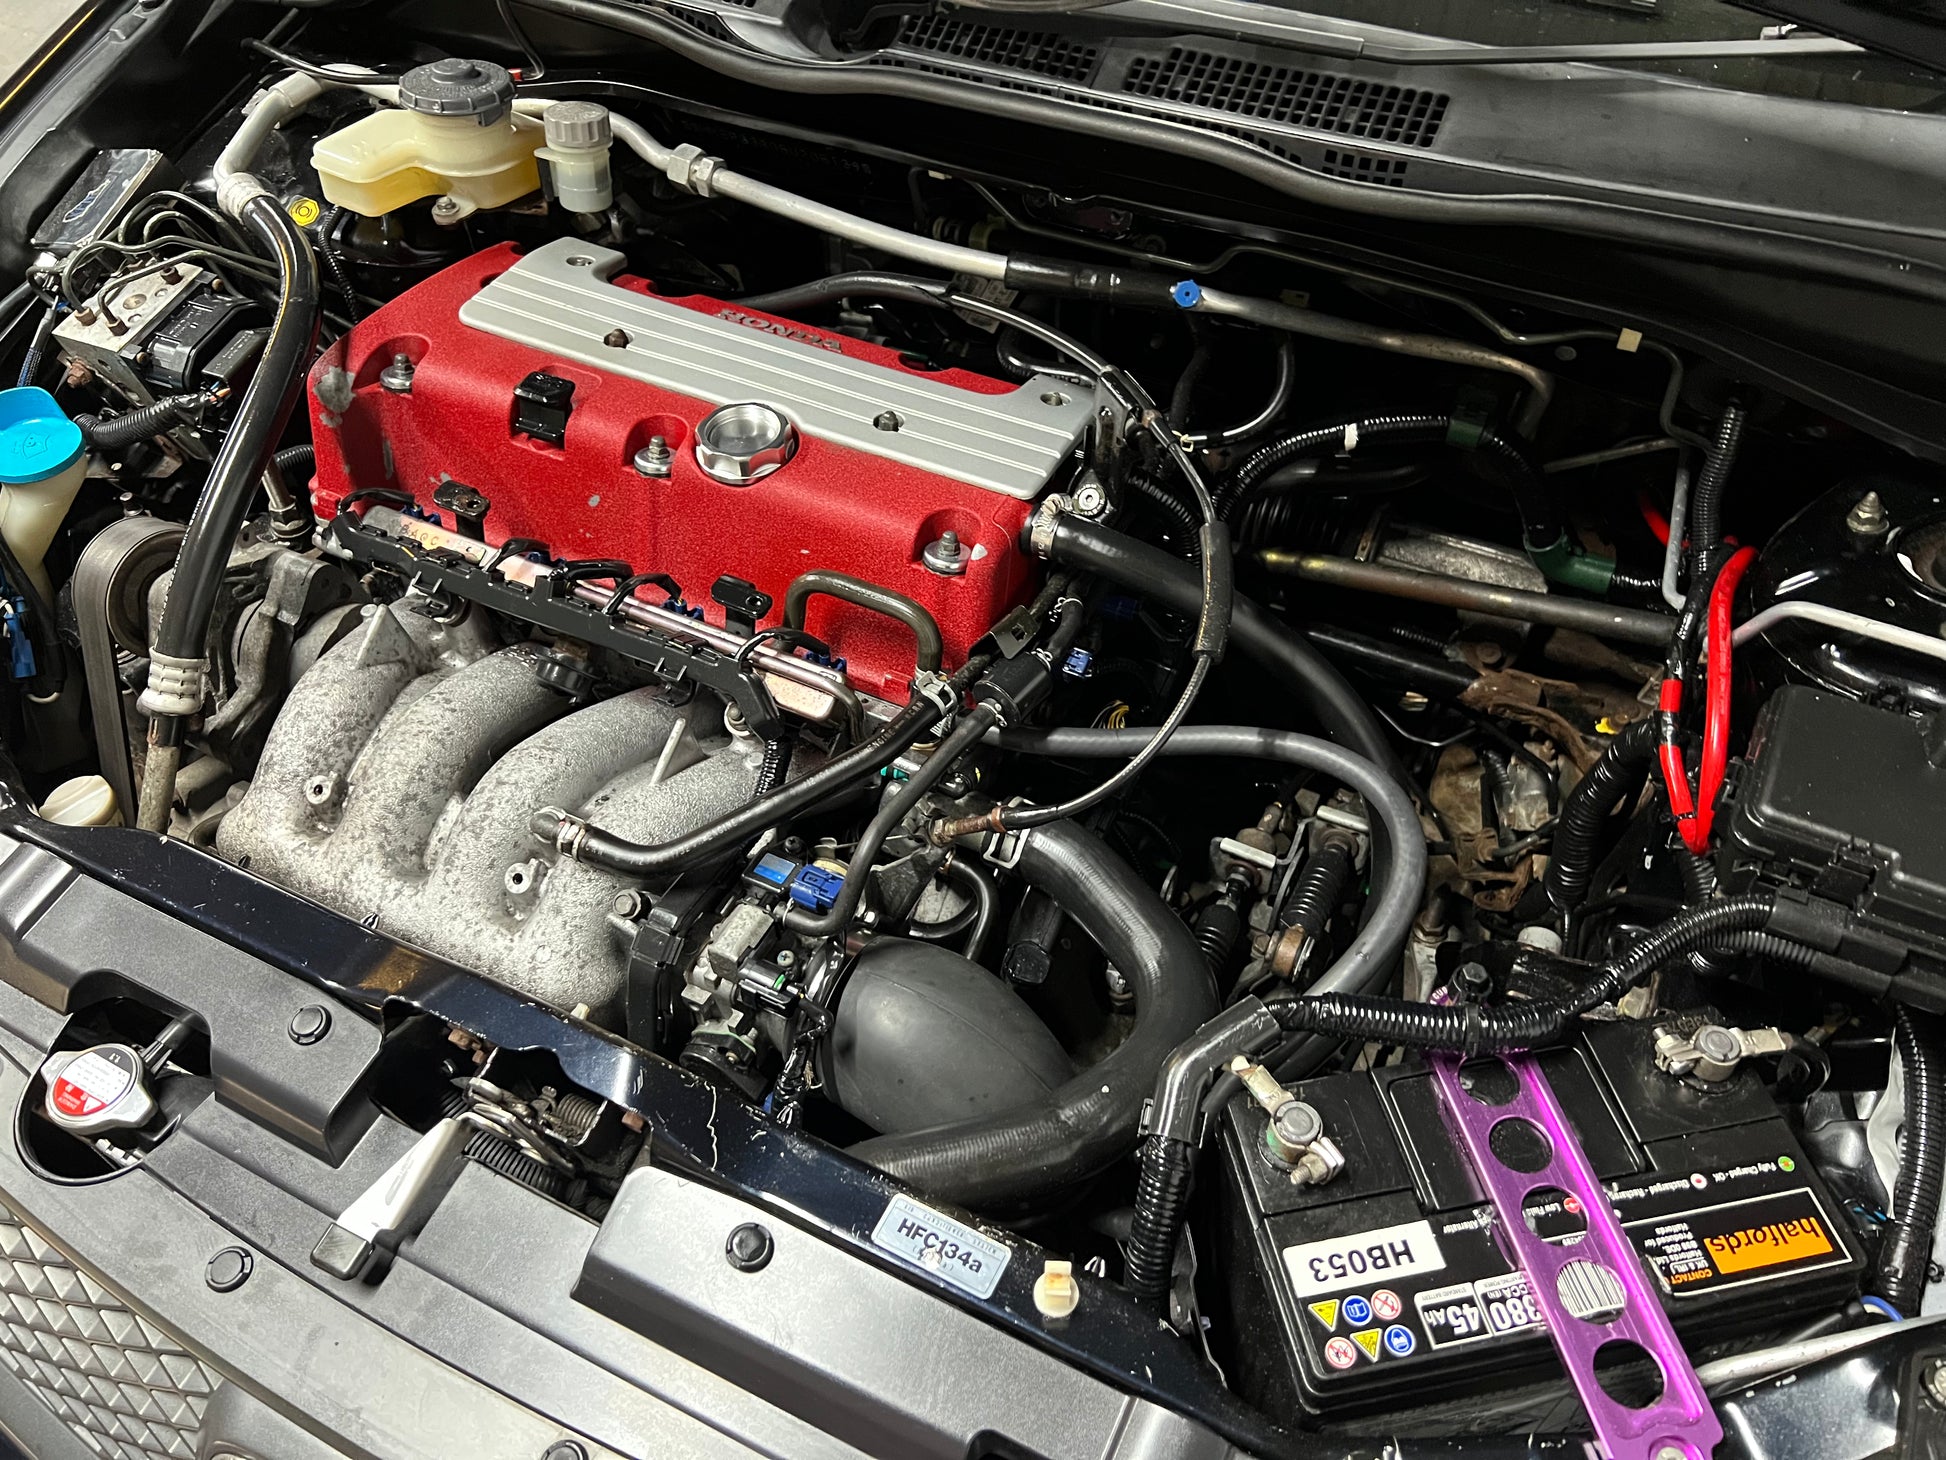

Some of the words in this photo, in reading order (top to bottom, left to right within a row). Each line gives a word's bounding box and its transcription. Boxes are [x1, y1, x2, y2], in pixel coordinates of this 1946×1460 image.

[713, 309, 842, 353] HONDA
[1650, 1179, 1690, 1195] Discharged
[1712, 1172, 1726, 1183] OK
[1729, 1165, 1758, 1179] Charged
[896, 1217, 983, 1274] HFC134a
[1709, 1216, 1821, 1255] halfords
[1308, 1239, 1416, 1282] HB053
[1671, 1269, 1713, 1285] CONTACT
[1489, 1294, 1543, 1331] 380
